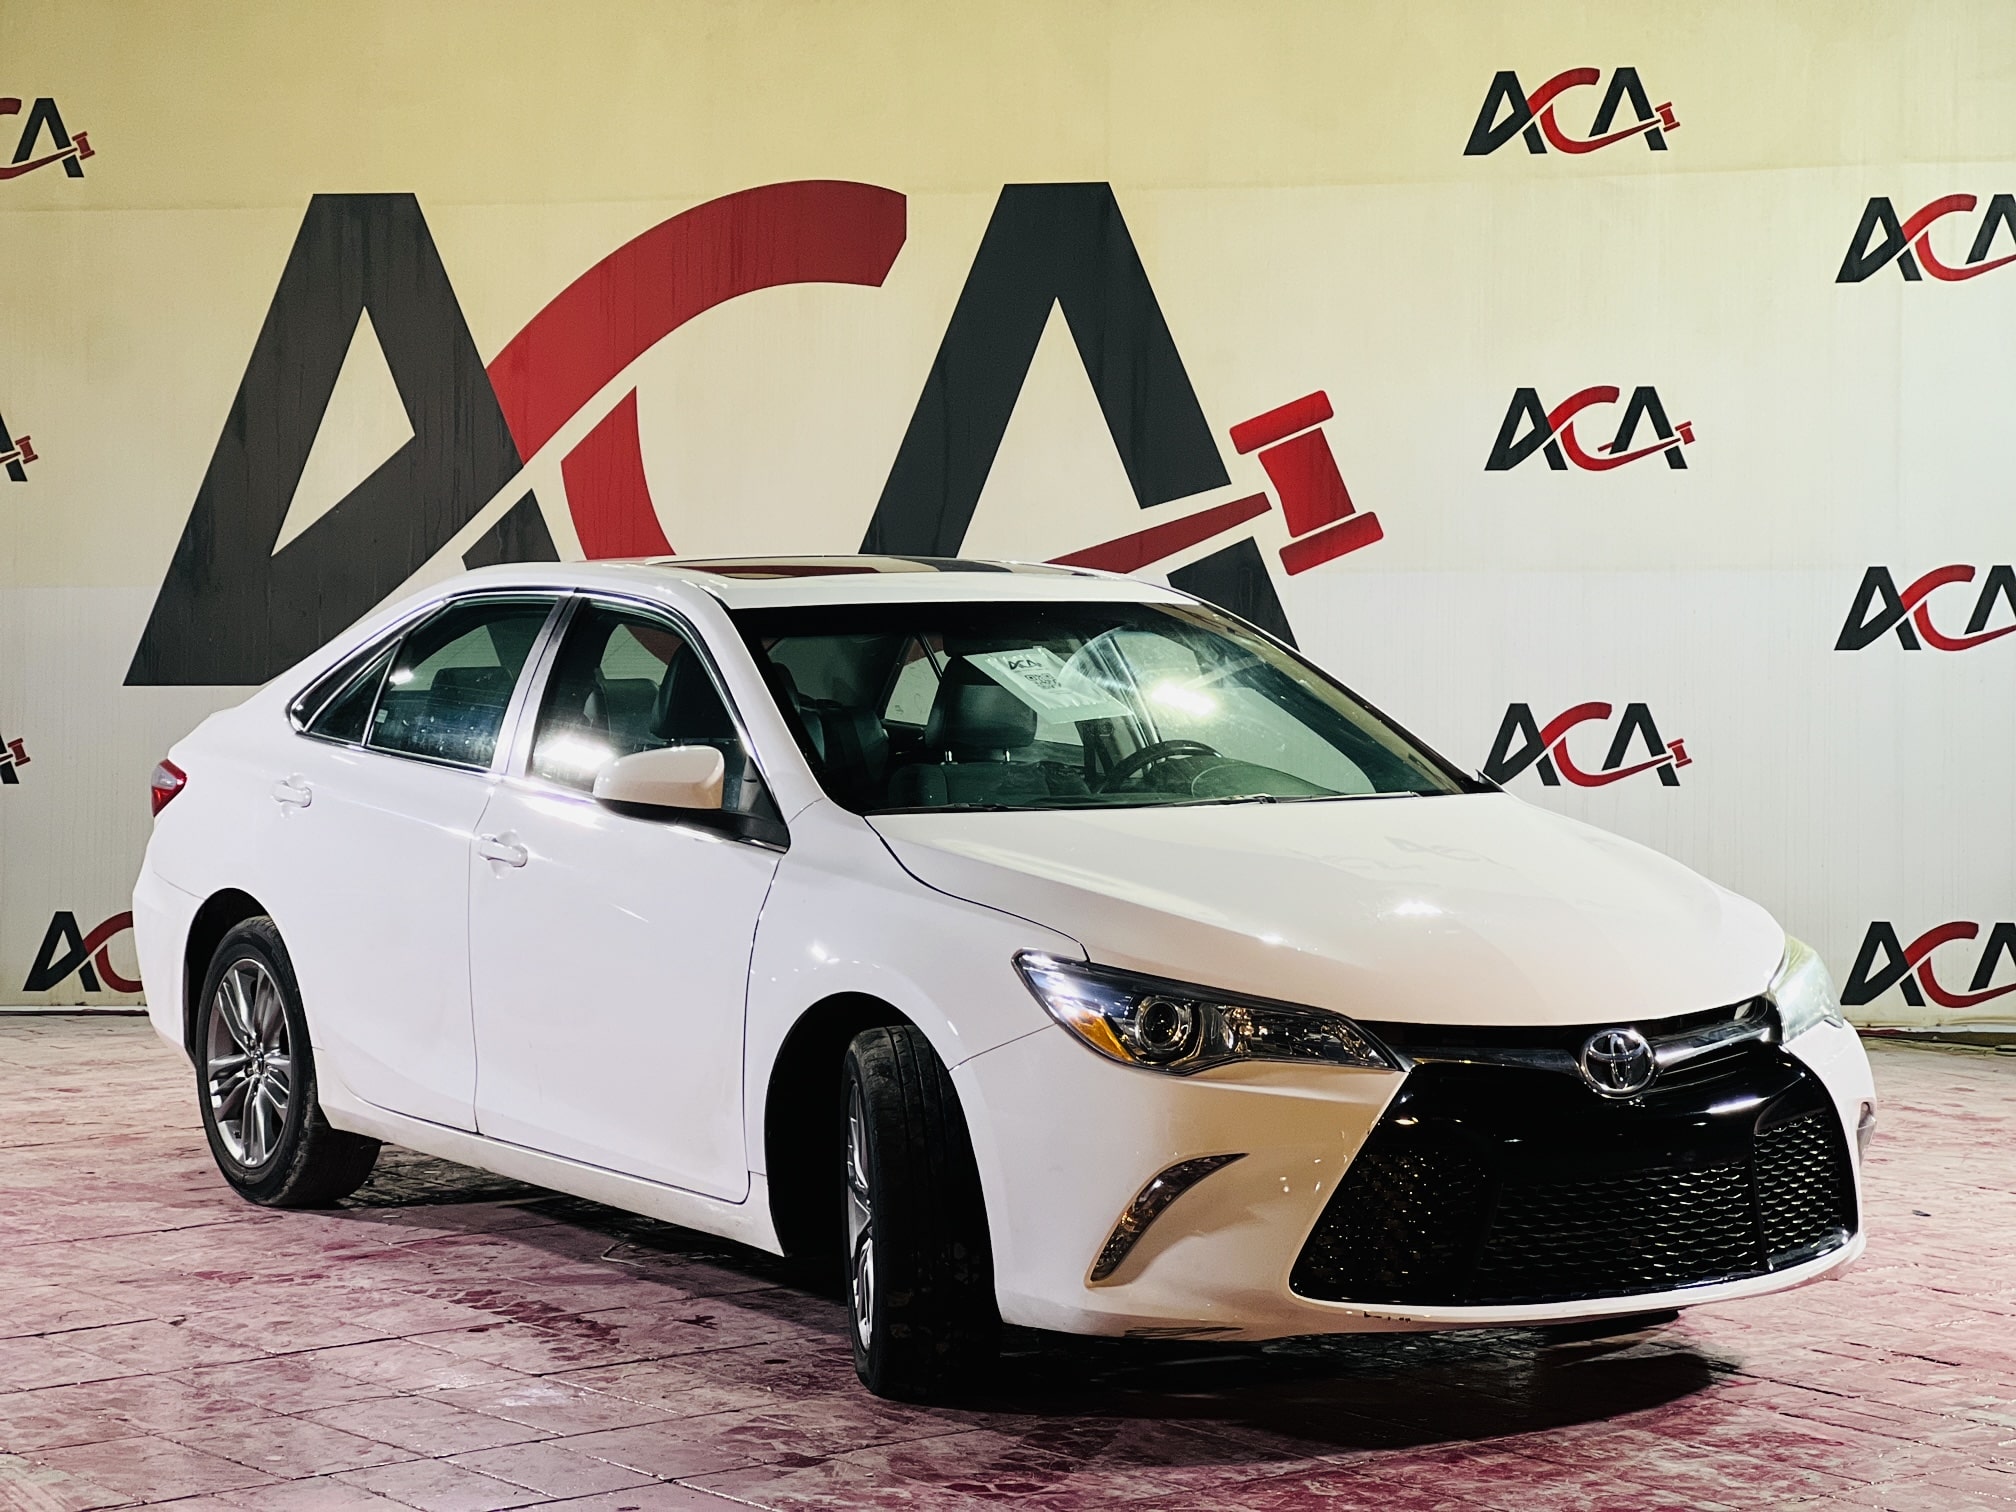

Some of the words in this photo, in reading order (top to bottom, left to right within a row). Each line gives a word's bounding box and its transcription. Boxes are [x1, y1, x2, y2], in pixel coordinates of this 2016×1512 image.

[1463, 67, 1668, 155] ACA
[1835, 193, 2016, 283] ACA
[123, 180, 1298, 685] ACA
[1484, 385, 1688, 471] ACA
[1834, 564, 2016, 651] ACA
[1483, 702, 1680, 787] ACA
[1840, 921, 2016, 1008] ACA
